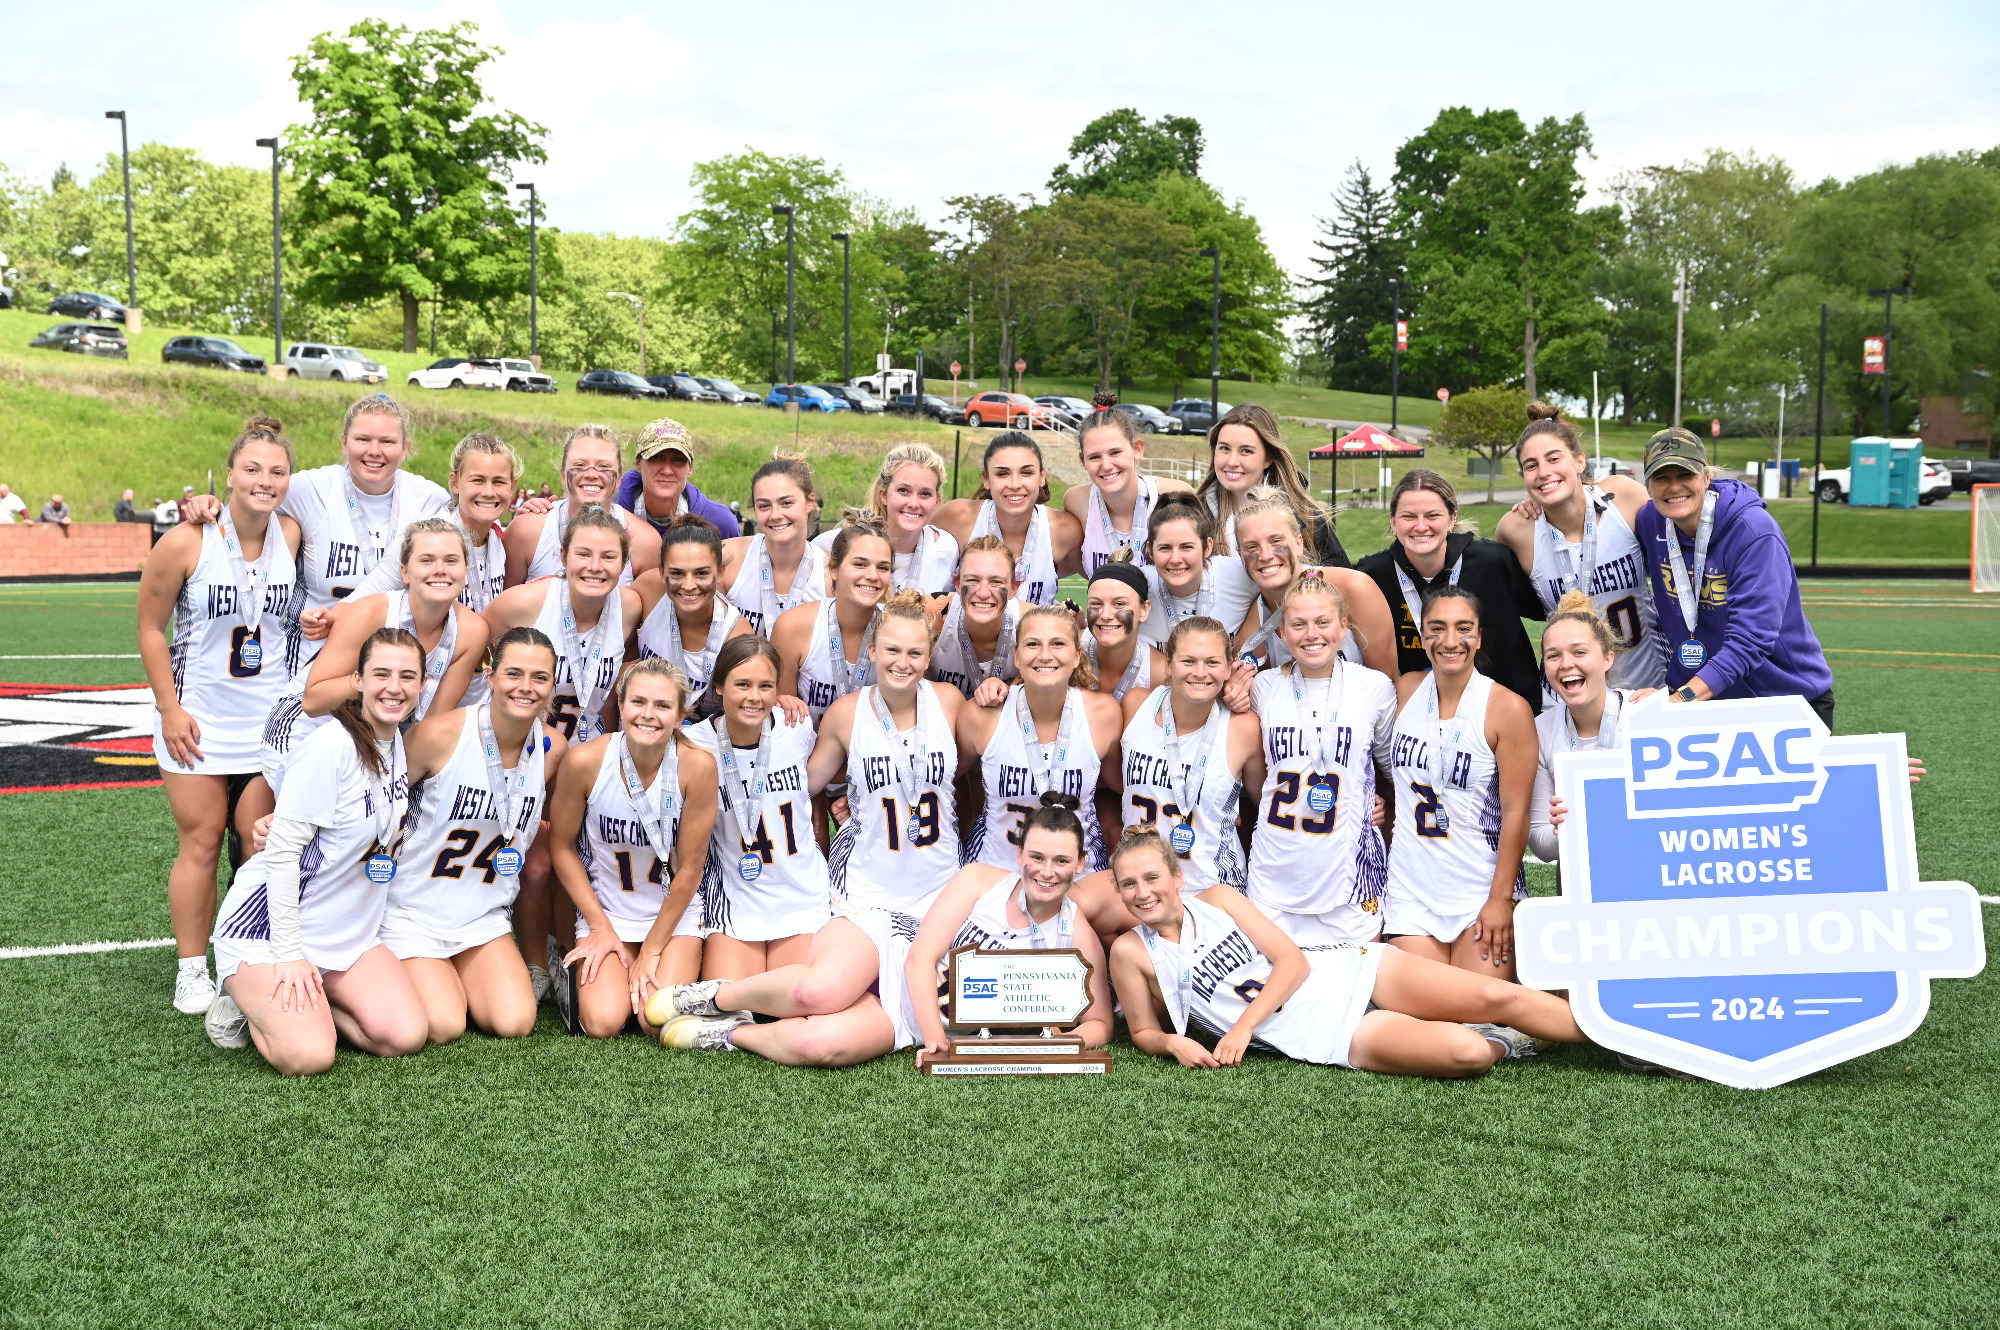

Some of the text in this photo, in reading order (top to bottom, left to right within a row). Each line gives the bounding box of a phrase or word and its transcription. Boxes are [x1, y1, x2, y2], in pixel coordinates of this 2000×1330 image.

[1660, 438, 1680, 451] 25
[326, 541, 361, 578] WEST
[809, 679, 838, 708] WEST
[1270, 727, 1296, 765] WEST
[1392, 732, 1420, 769] WEST
[1630, 728, 1814, 782] PSAC
[764, 765, 802, 793] ESTER
[863, 756, 891, 794] WEST
[1000, 764, 1028, 798] WEST
[1126, 750, 1153, 786] WEST
[449, 785, 487, 821] WEST
[1268, 770, 1341, 835] 23
[1410, 780, 1449, 839] 2
[599, 814, 627, 844] WEST
[741, 800, 798, 865] 41
[881, 792, 941, 852] 19
[1174, 832, 1192, 840] PSAC
[1659, 823, 1808, 853] WOMEN'S
[370, 863, 392, 871] PSAC
[429, 827, 516, 885] 24
[1660, 858, 1812, 887] LACROSSE
[1540, 906, 1954, 964] CHAMPIONS
[1201, 930, 1253, 981] CHESTER
[964, 984, 998, 993] PSAC
[1712, 997, 1784, 1021] 2024
